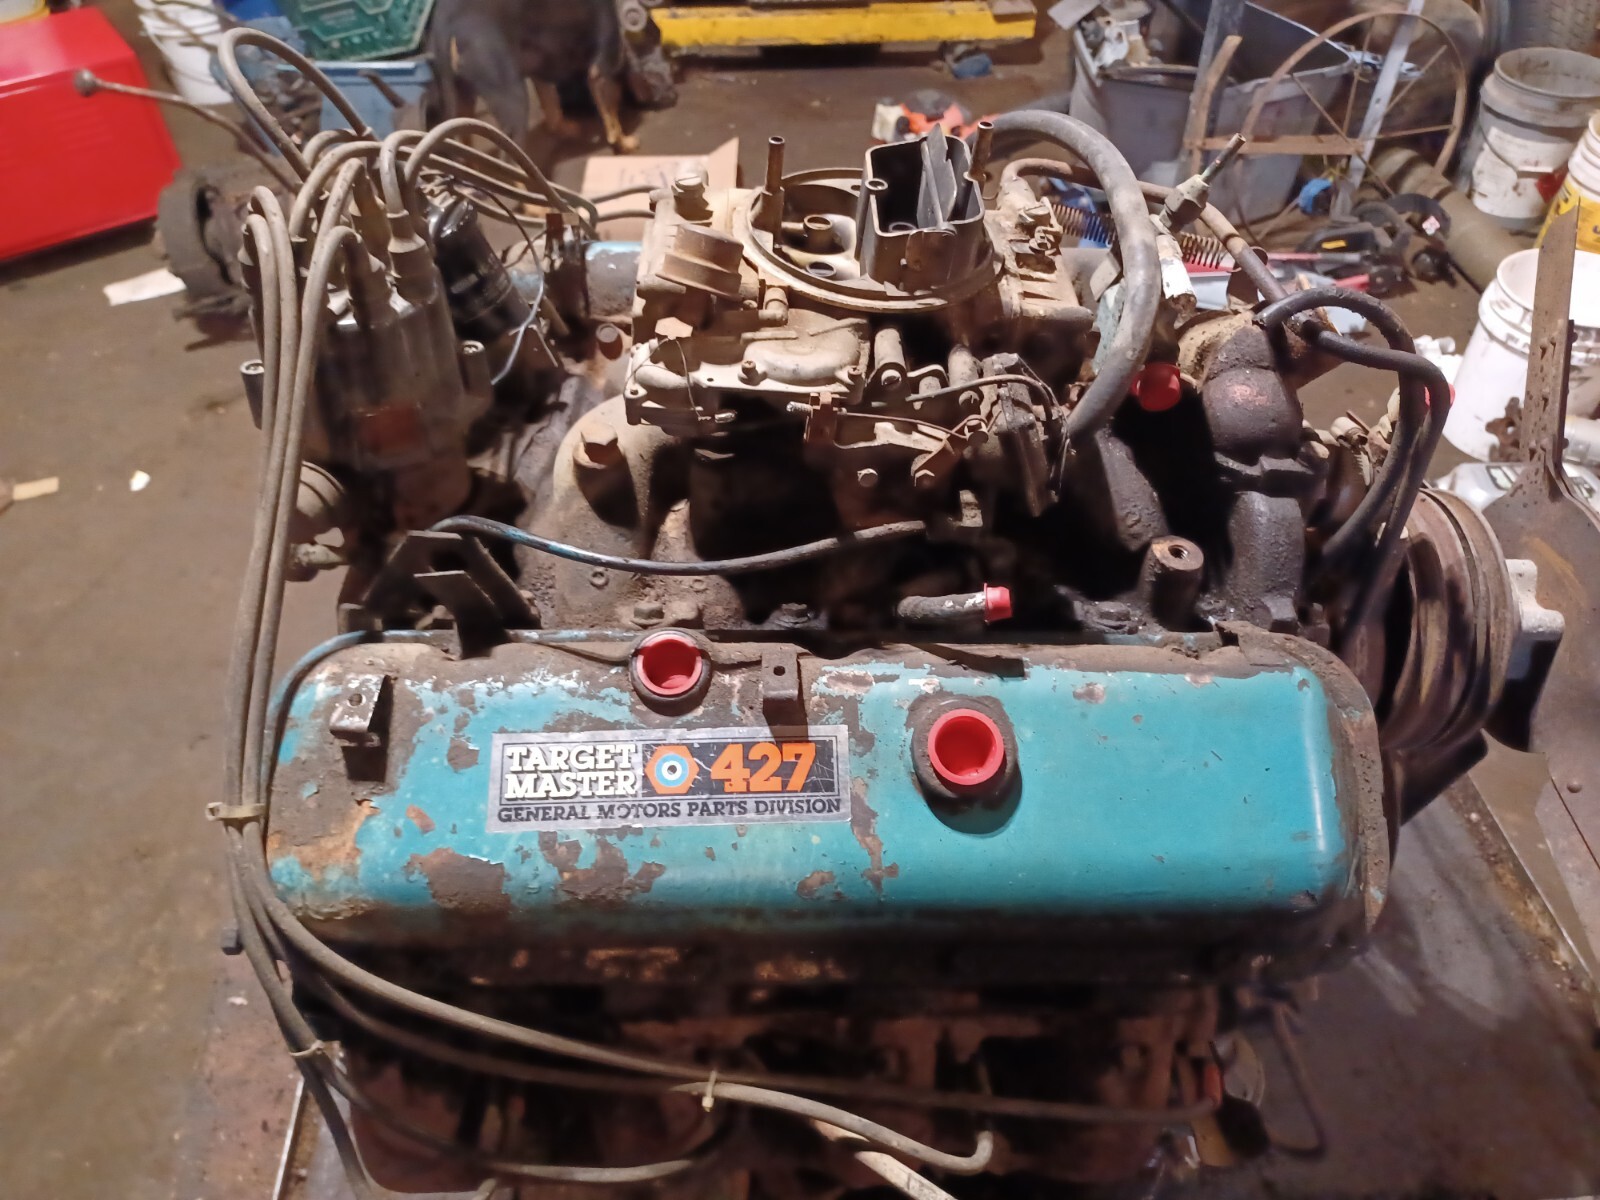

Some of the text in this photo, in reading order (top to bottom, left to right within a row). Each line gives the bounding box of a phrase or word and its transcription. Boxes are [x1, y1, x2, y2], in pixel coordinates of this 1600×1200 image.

[505, 744, 636, 772] TARGET
[710, 742, 816, 793] 427
[504, 771, 636, 800] MASTER
[497, 798, 841, 822] GENERAL MOTORS PARTS DIVISION
